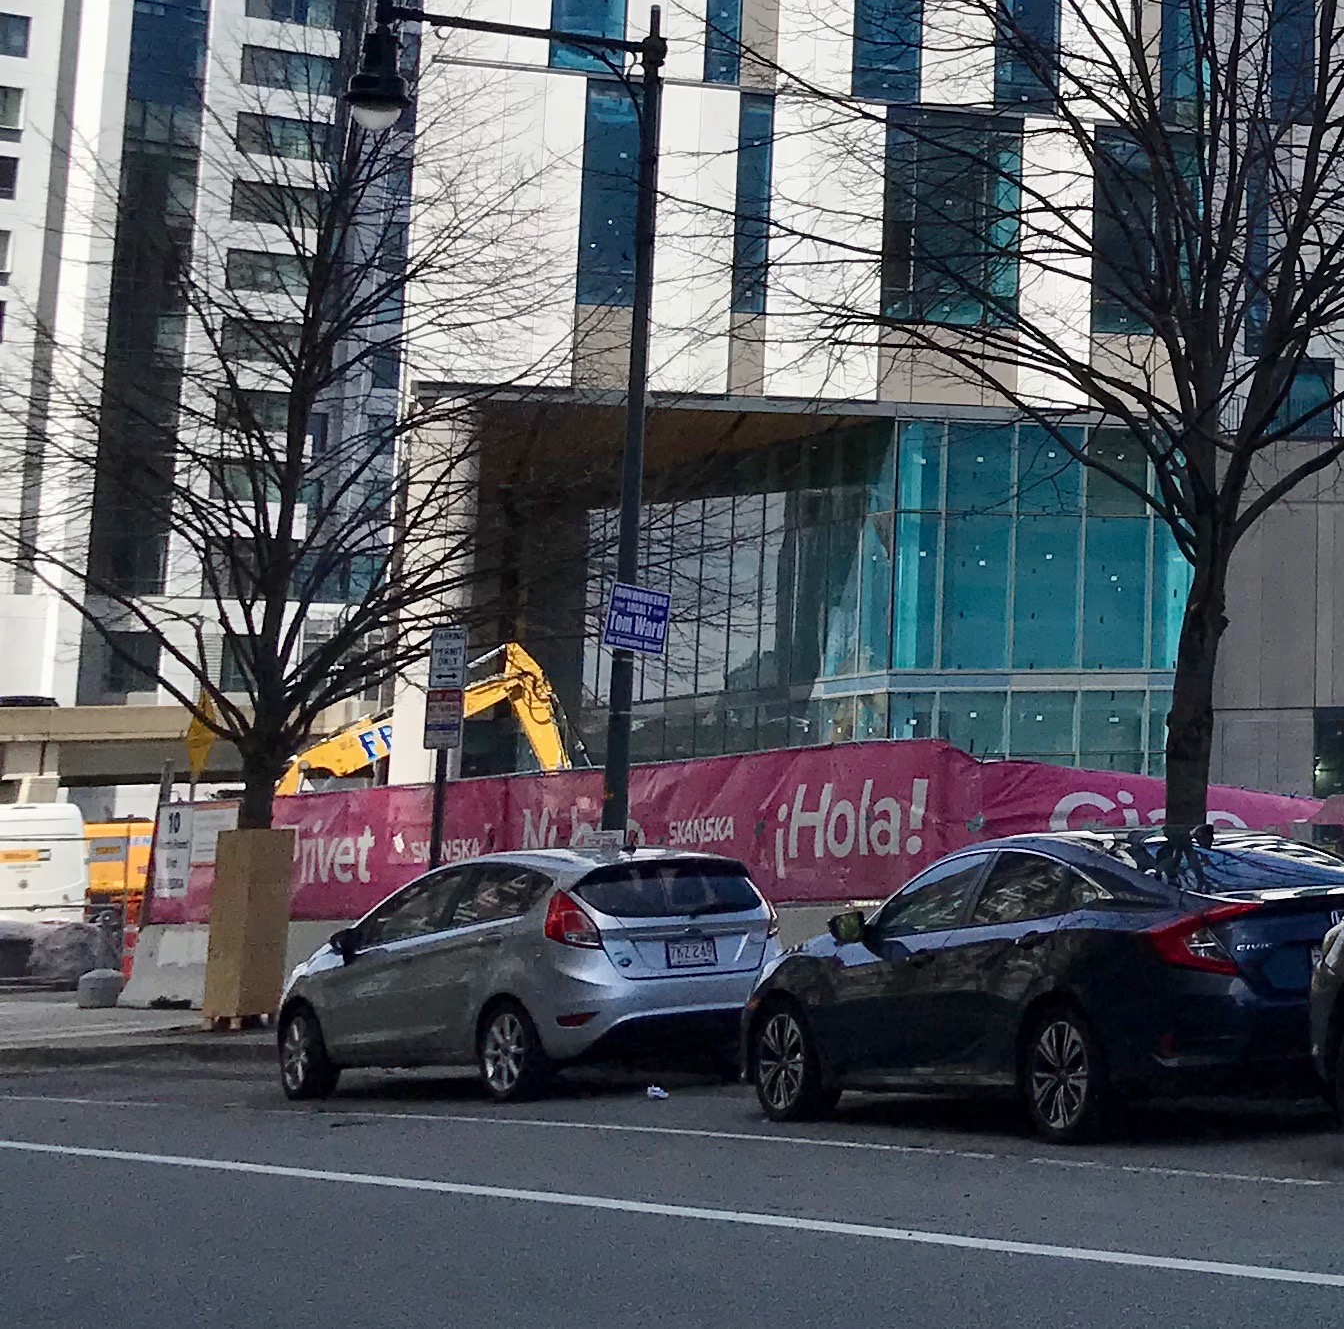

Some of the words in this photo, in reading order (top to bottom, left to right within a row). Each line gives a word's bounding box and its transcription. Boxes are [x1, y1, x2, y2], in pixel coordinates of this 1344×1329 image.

[610, 610, 633, 633] Tom
[634, 614, 665, 640] Ward
[1049, 790, 1249, 831] Ci
[668, 816, 735, 845] SKANSKA
[775, 778, 930, 880] ¡Hola!
[410, 837, 480, 863] SKNSKA
[1236, 942, 1273, 951] CIVIC
